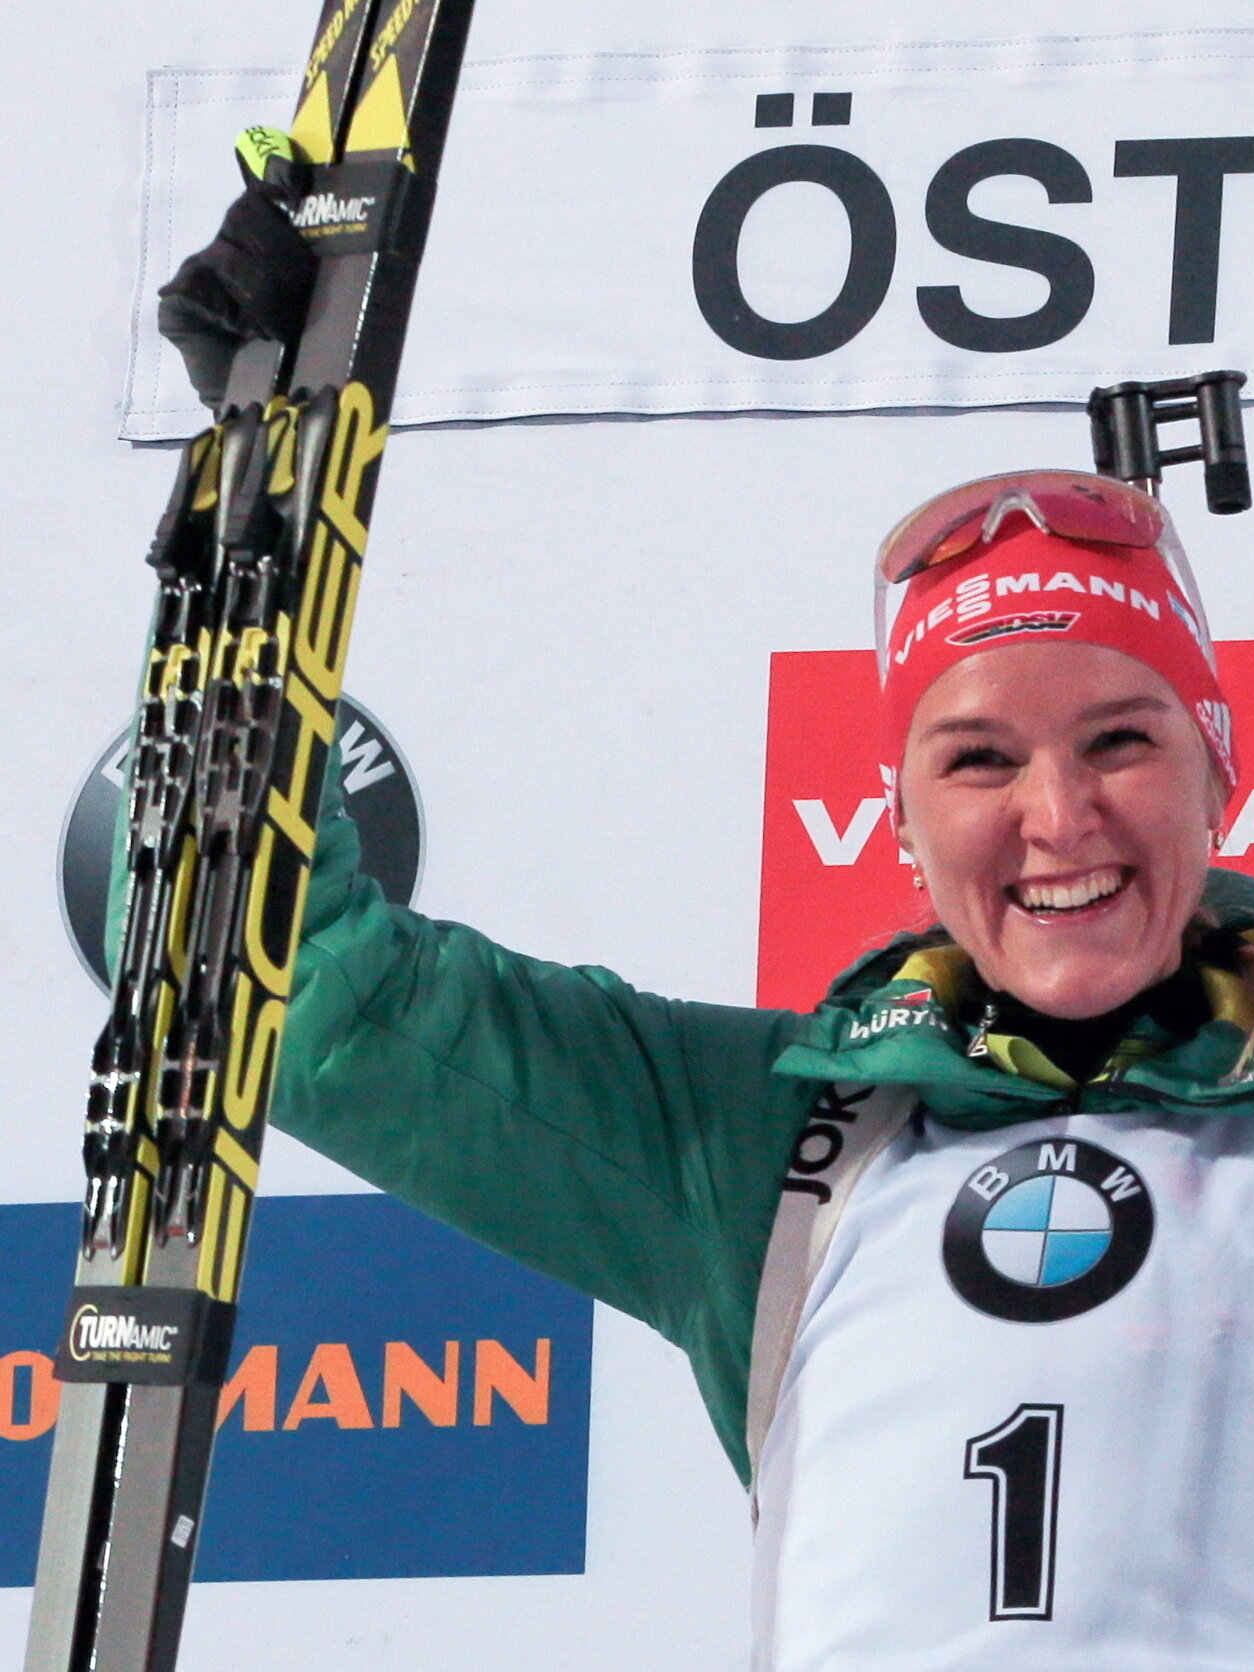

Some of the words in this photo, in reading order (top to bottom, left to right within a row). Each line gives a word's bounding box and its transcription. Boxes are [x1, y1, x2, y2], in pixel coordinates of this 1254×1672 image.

[894, 571, 1161, 665] VIESSMANN
[781, 1081, 877, 1206] JOK
[968, 1143, 1142, 1203] BMW
[0, 1338, 551, 1441] OMANN
[963, 1403, 1065, 1622] 1
